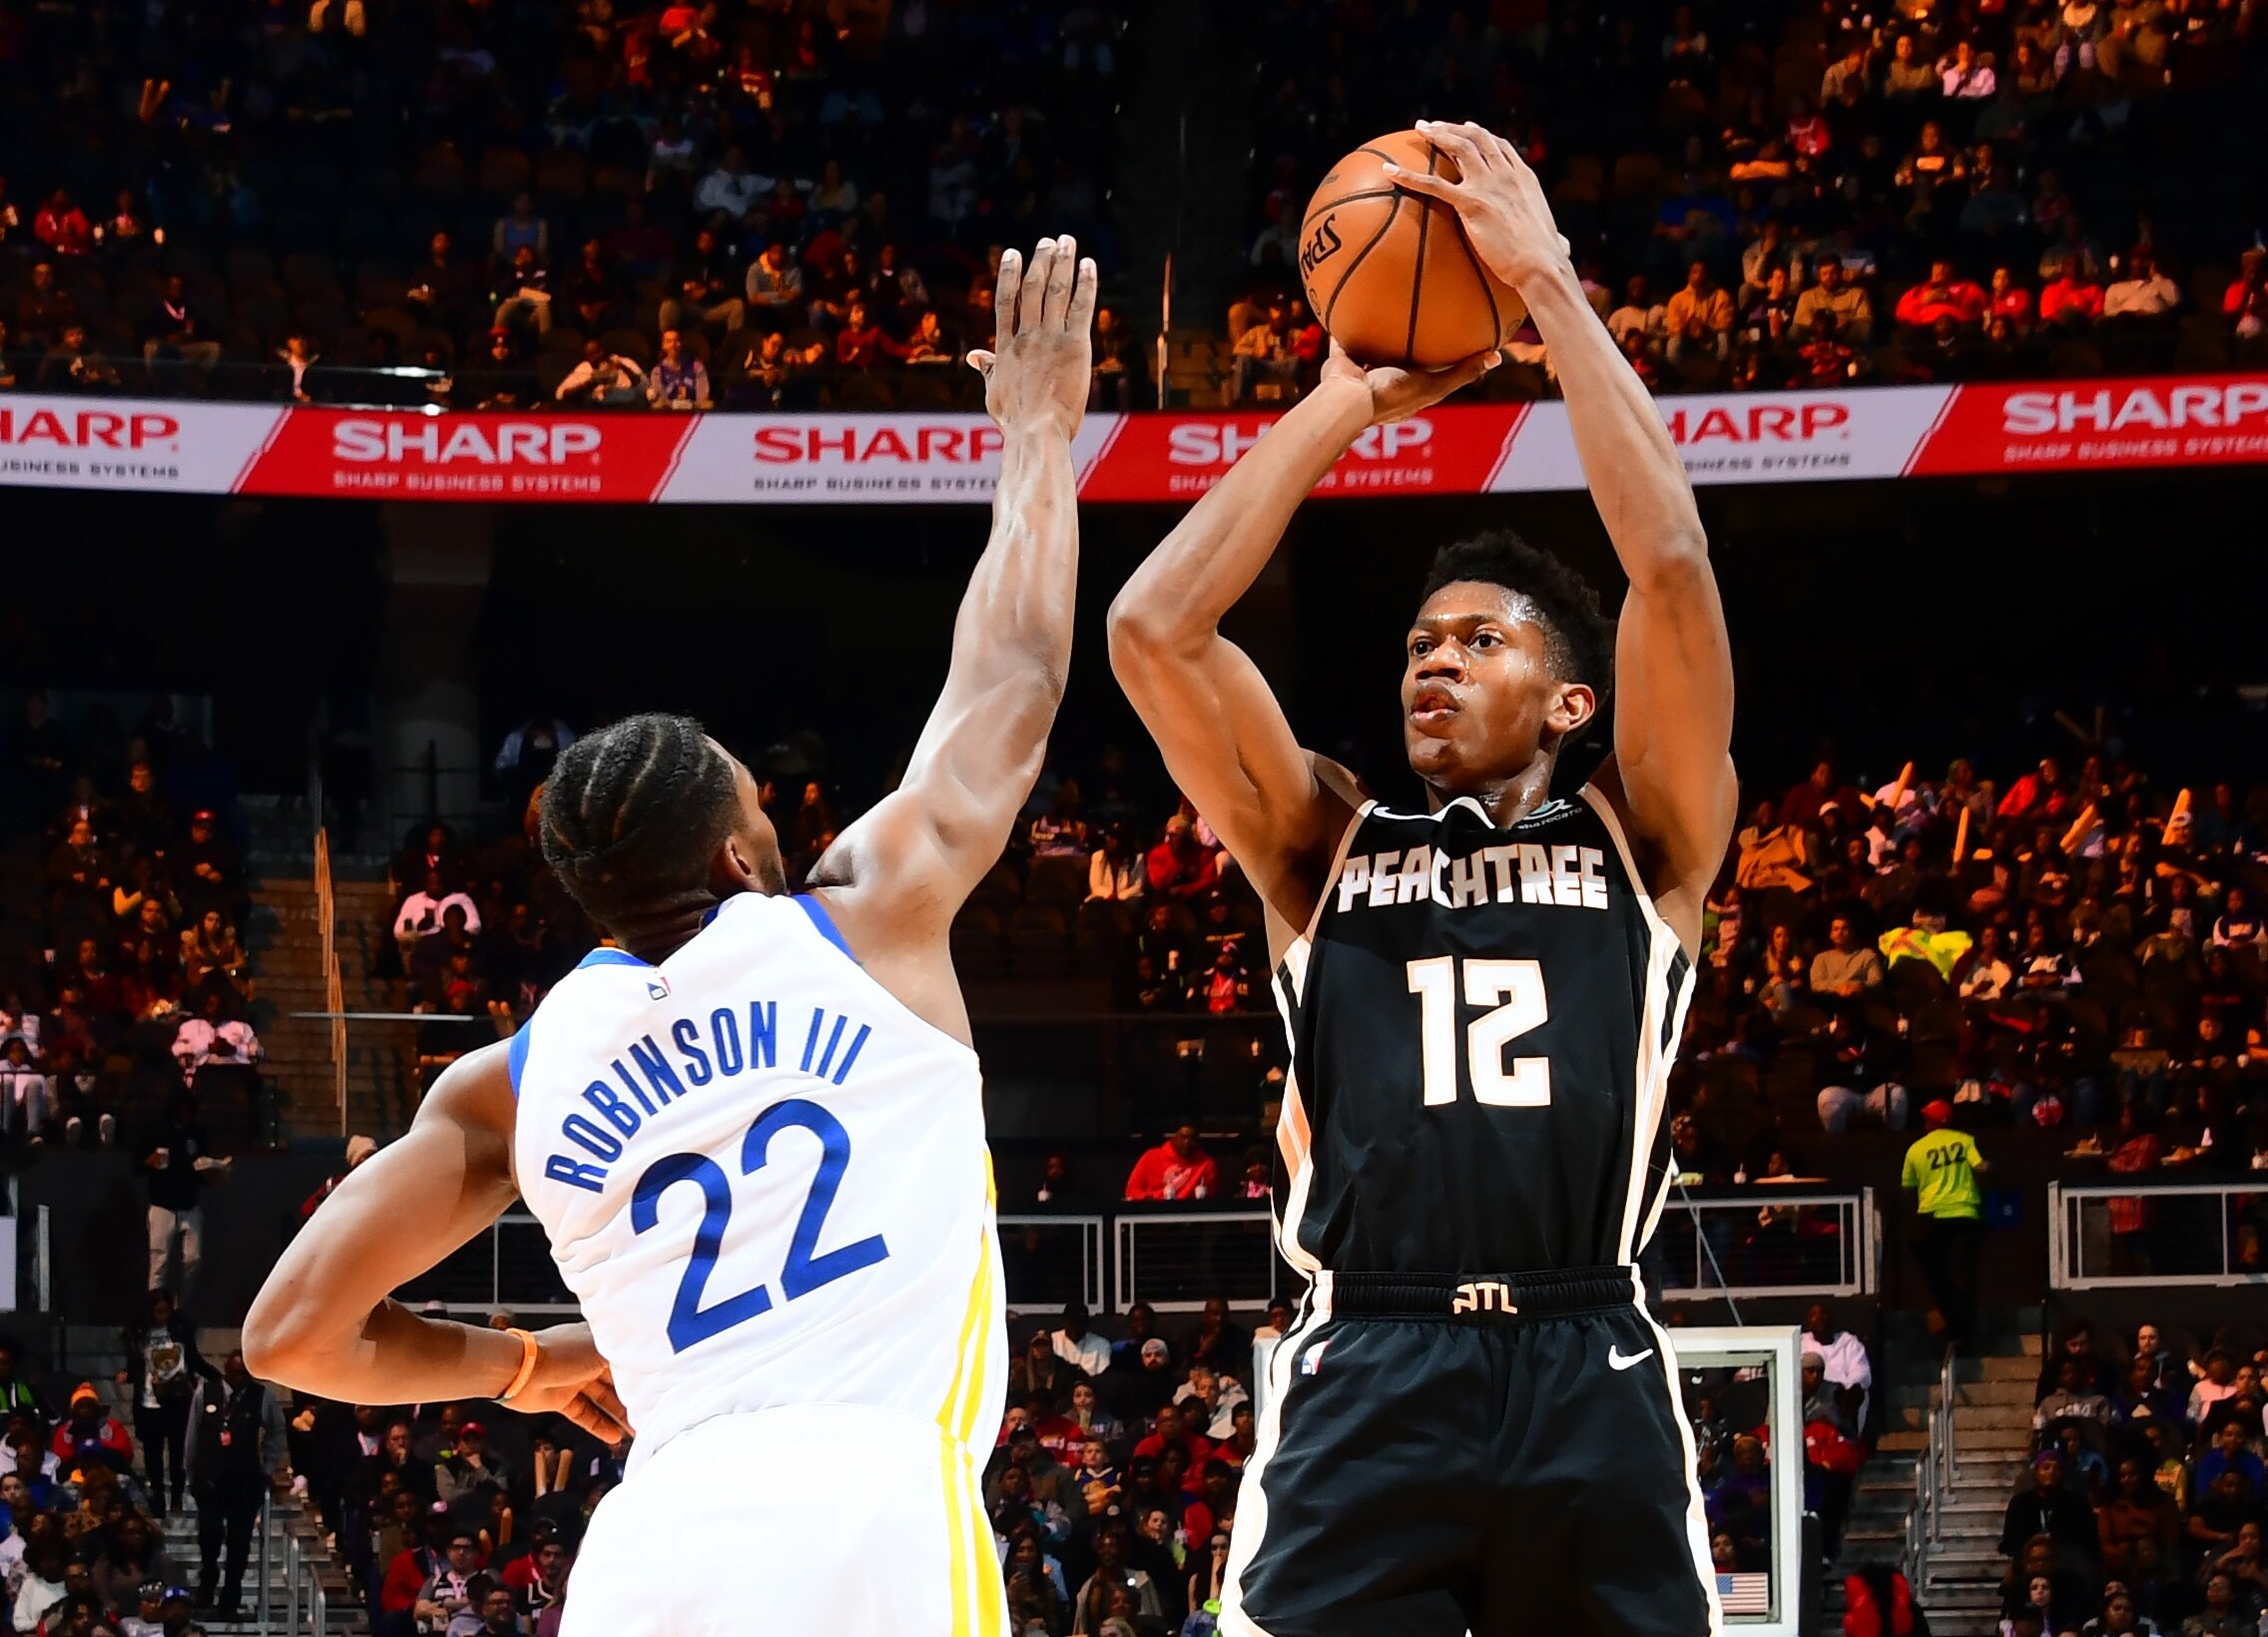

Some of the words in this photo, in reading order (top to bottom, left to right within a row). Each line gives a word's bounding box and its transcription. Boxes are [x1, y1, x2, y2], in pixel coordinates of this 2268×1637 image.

[332, 418, 602, 465] SHARP
[754, 426, 1005, 464] SHARP
[90, 463, 180, 477] SYSTEMS
[1761, 454, 1851, 469] SYSTEMS
[333, 470, 399, 488] SHARP
[405, 472, 504, 491] BUSINESS
[511, 474, 602, 492] SYSTEMS
[755, 476, 818, 490] SHARP
[826, 476, 921, 491] BUSINESS
[1344, 469, 1434, 488] SYSTEMS
[1337, 843, 1610, 913] PEACHTREE
[1406, 954, 1552, 1108] 12
[544, 1000, 778, 1195] ROBINSON
[800, 1006, 873, 1086] III
[1926, 1141, 1967, 1171] 212
[630, 1097, 891, 1356] 22
[1451, 1282, 1518, 1315] ATL
